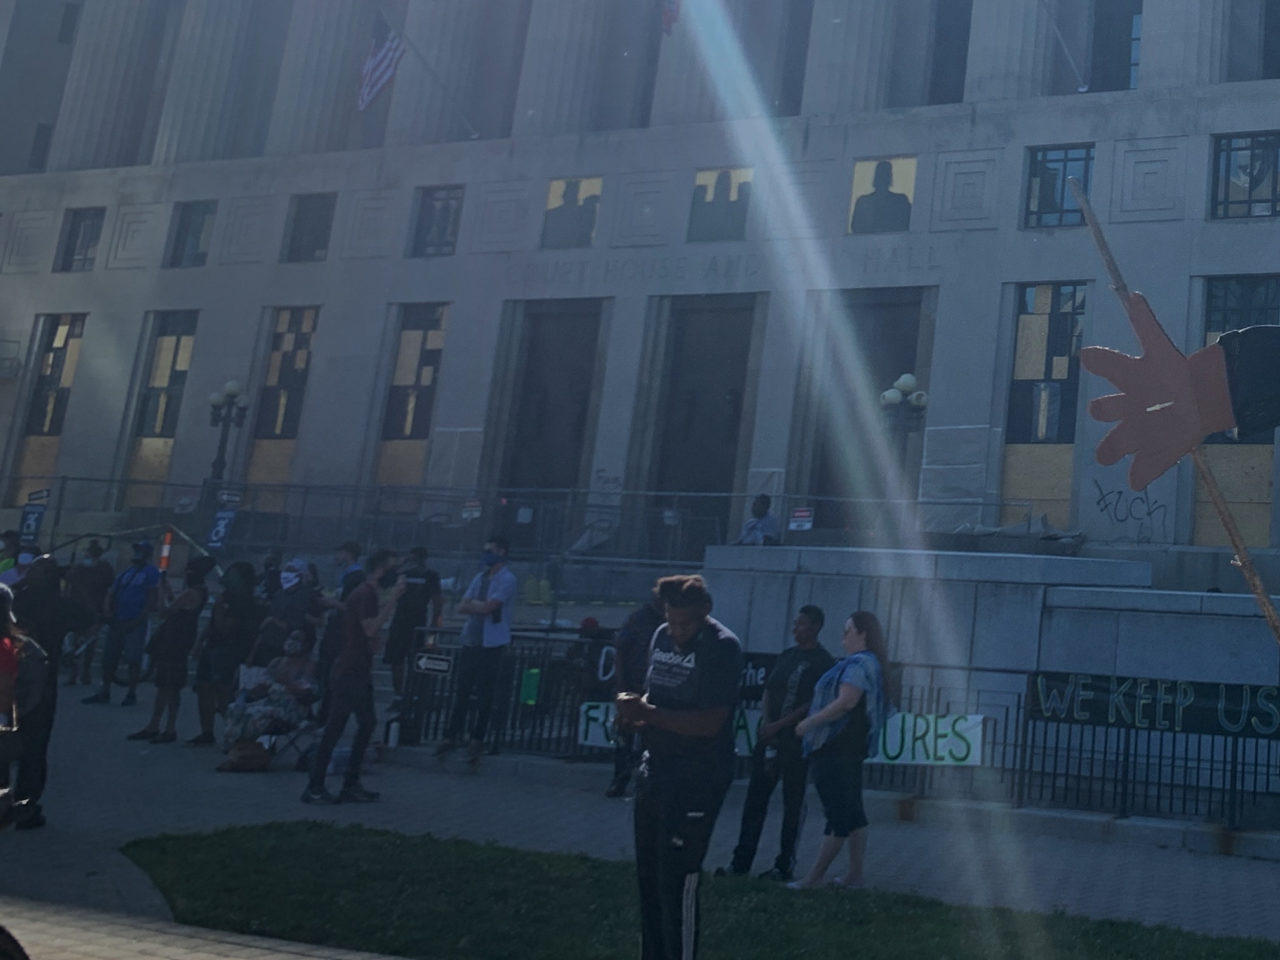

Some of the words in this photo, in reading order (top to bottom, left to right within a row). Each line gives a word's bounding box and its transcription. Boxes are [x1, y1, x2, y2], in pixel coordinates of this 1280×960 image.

[603, 254, 690, 286] HOUSE
[863, 245, 943, 273] HALL
[1037, 673, 1095, 721] WE
[1108, 677, 1196, 732] KEEP
[1217, 684, 1280, 735] US
[882, 712, 971, 762] URES
